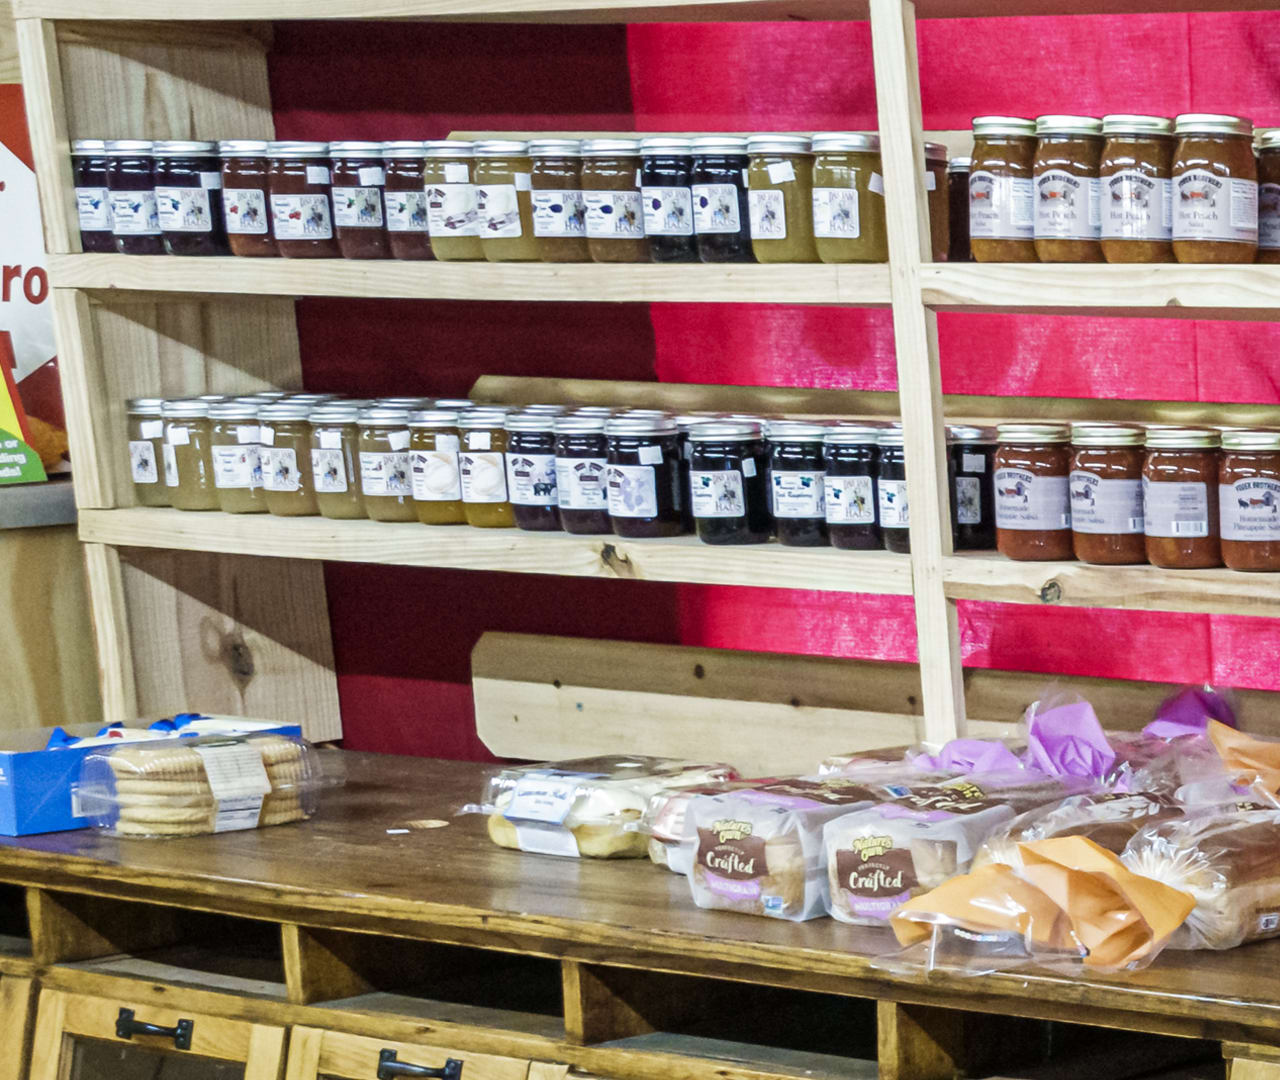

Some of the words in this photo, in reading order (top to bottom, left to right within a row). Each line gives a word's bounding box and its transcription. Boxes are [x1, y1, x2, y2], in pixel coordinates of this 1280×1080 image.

[2, 264, 49, 305] ro
[705, 851, 755, 875] Crafted
[849, 870, 905, 893] Crafted
